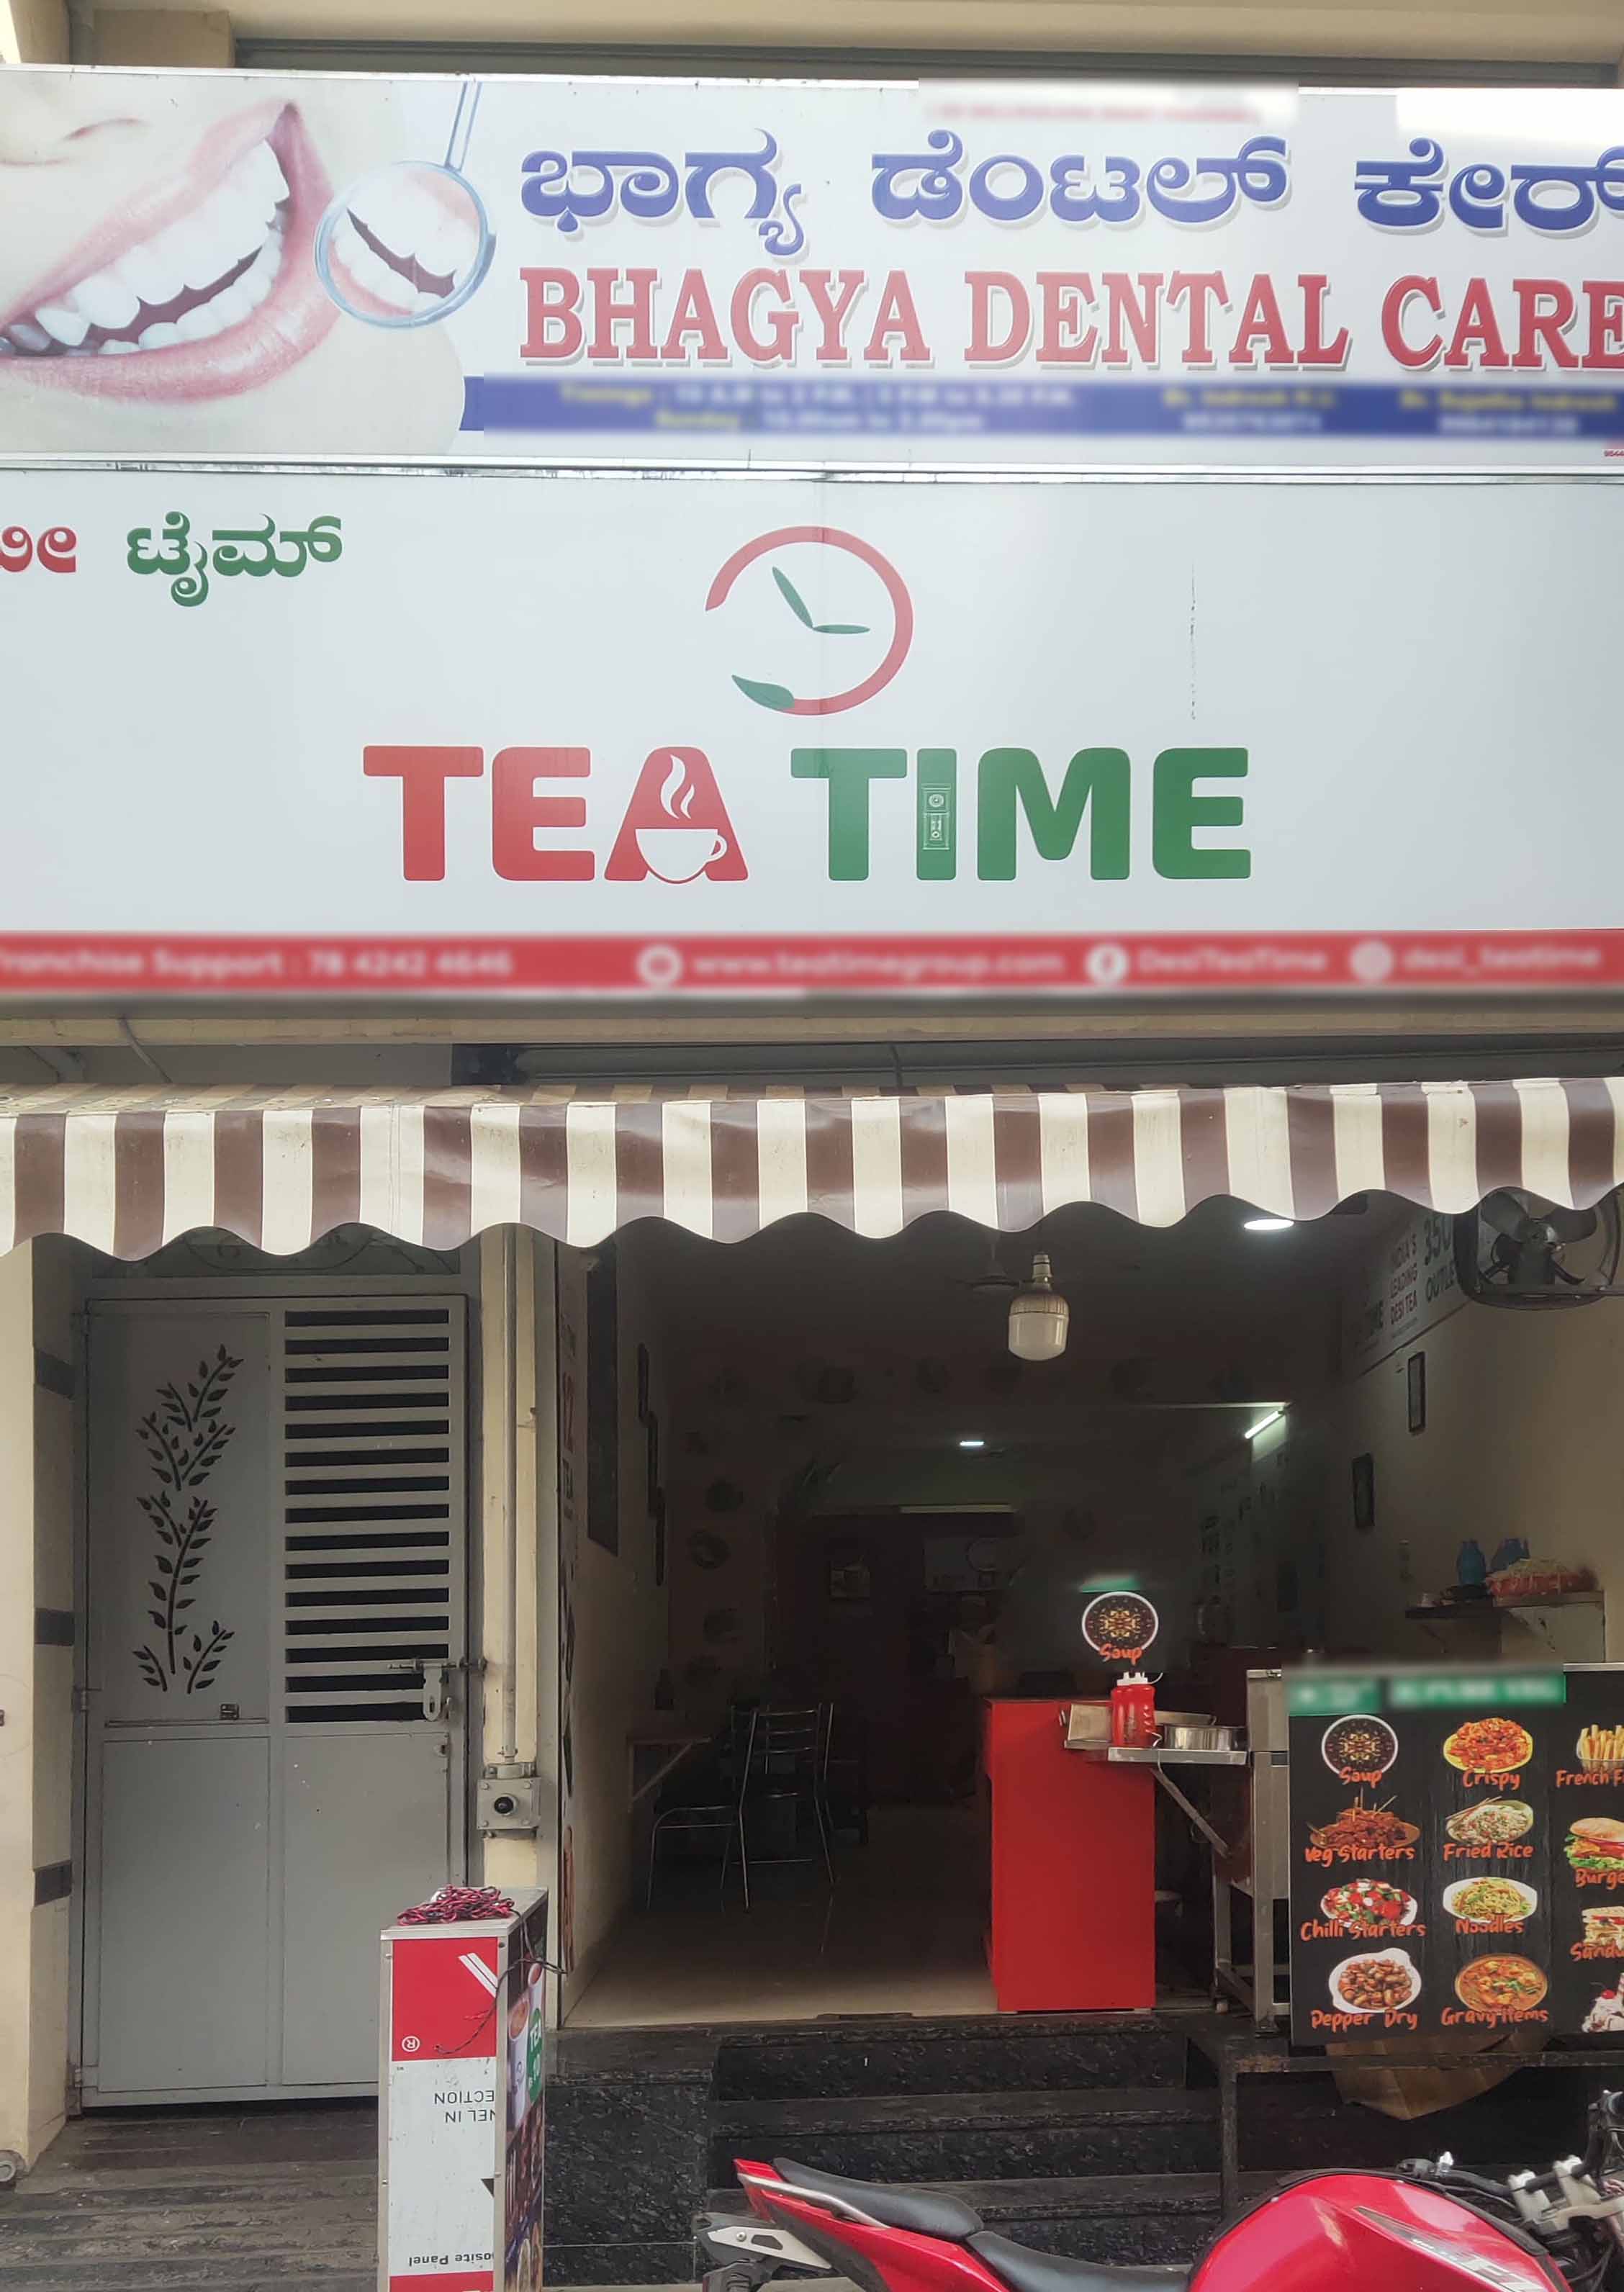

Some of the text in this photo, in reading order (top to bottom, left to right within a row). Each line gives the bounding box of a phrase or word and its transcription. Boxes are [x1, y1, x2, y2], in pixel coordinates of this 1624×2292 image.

[520, 128, 805, 256] ಭಾಗ್ಯ
[872, 130, 1287, 223] ಡೆಂಟಲ್
[519, 267, 1624, 369] BHAGYA DENTAL CARE
[127, 510, 343, 608] ಟೈಮ್
[363, 746, 1251, 884] TEA TIME
[1099, 1642, 1143, 1666] Soup
[1339, 1767, 1383, 1789] Soup
[1462, 1769, 1521, 1790] Crispy
[1556, 1769, 1610, 1788] French
[1337, 1844, 1416, 1864] Starters
[1443, 1842, 1534, 1862] Fried Rice
[1301, 1919, 1427, 1941] Chilli Starters
[1456, 1913, 1525, 1935] Noodles
[1311, 2007, 1418, 2033] Pepper Dry
[1441, 2007, 1497, 2029] Gravy
[444, 2110, 462, 2124] IN
[408, 2252, 495, 2268] osite Panel
